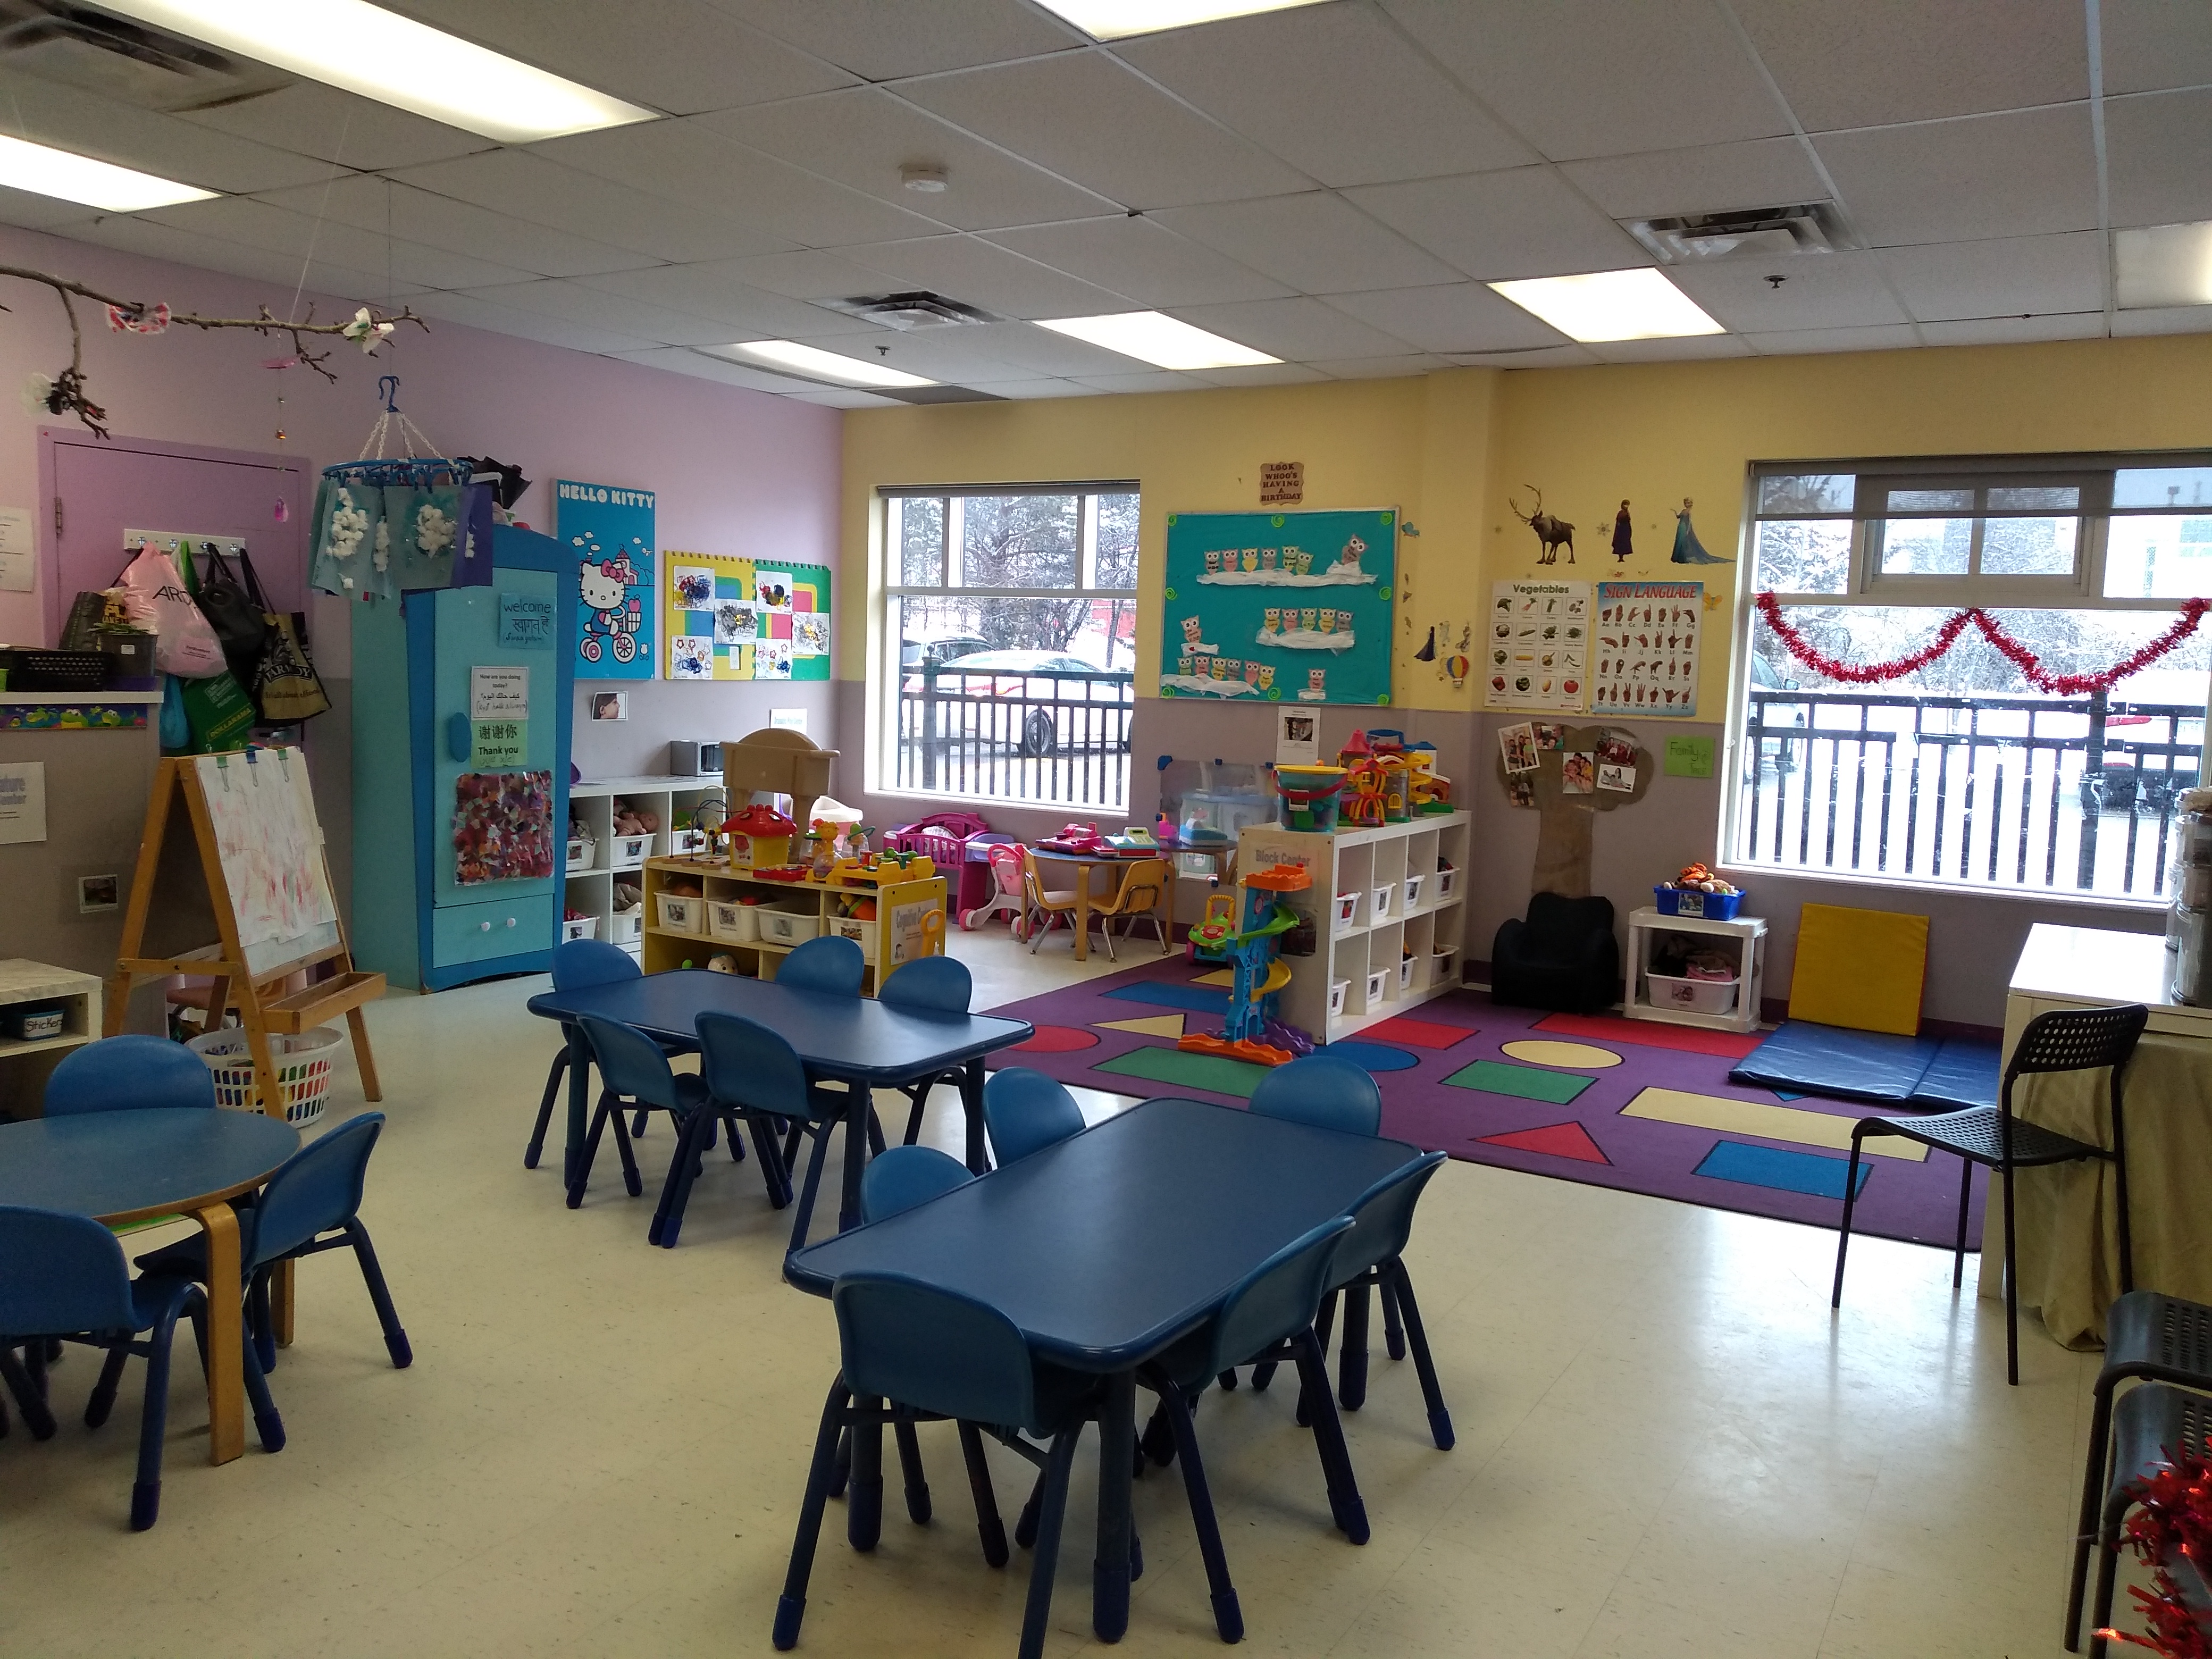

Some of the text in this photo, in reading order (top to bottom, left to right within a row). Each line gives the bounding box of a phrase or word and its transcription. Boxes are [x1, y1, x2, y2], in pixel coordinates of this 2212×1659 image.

[1265, 471, 1297, 480] WHOO'S
[559, 483, 653, 509] HELLO KITTY
[1513, 584, 1570, 594] Vegetables
[504, 599, 551, 613] welcome
[478, 724, 517, 740] 谢谢你
[478, 746, 518, 756] Thank you
[1670, 741, 1699, 761] Family
[1255, 849, 1311, 867] Block Center
